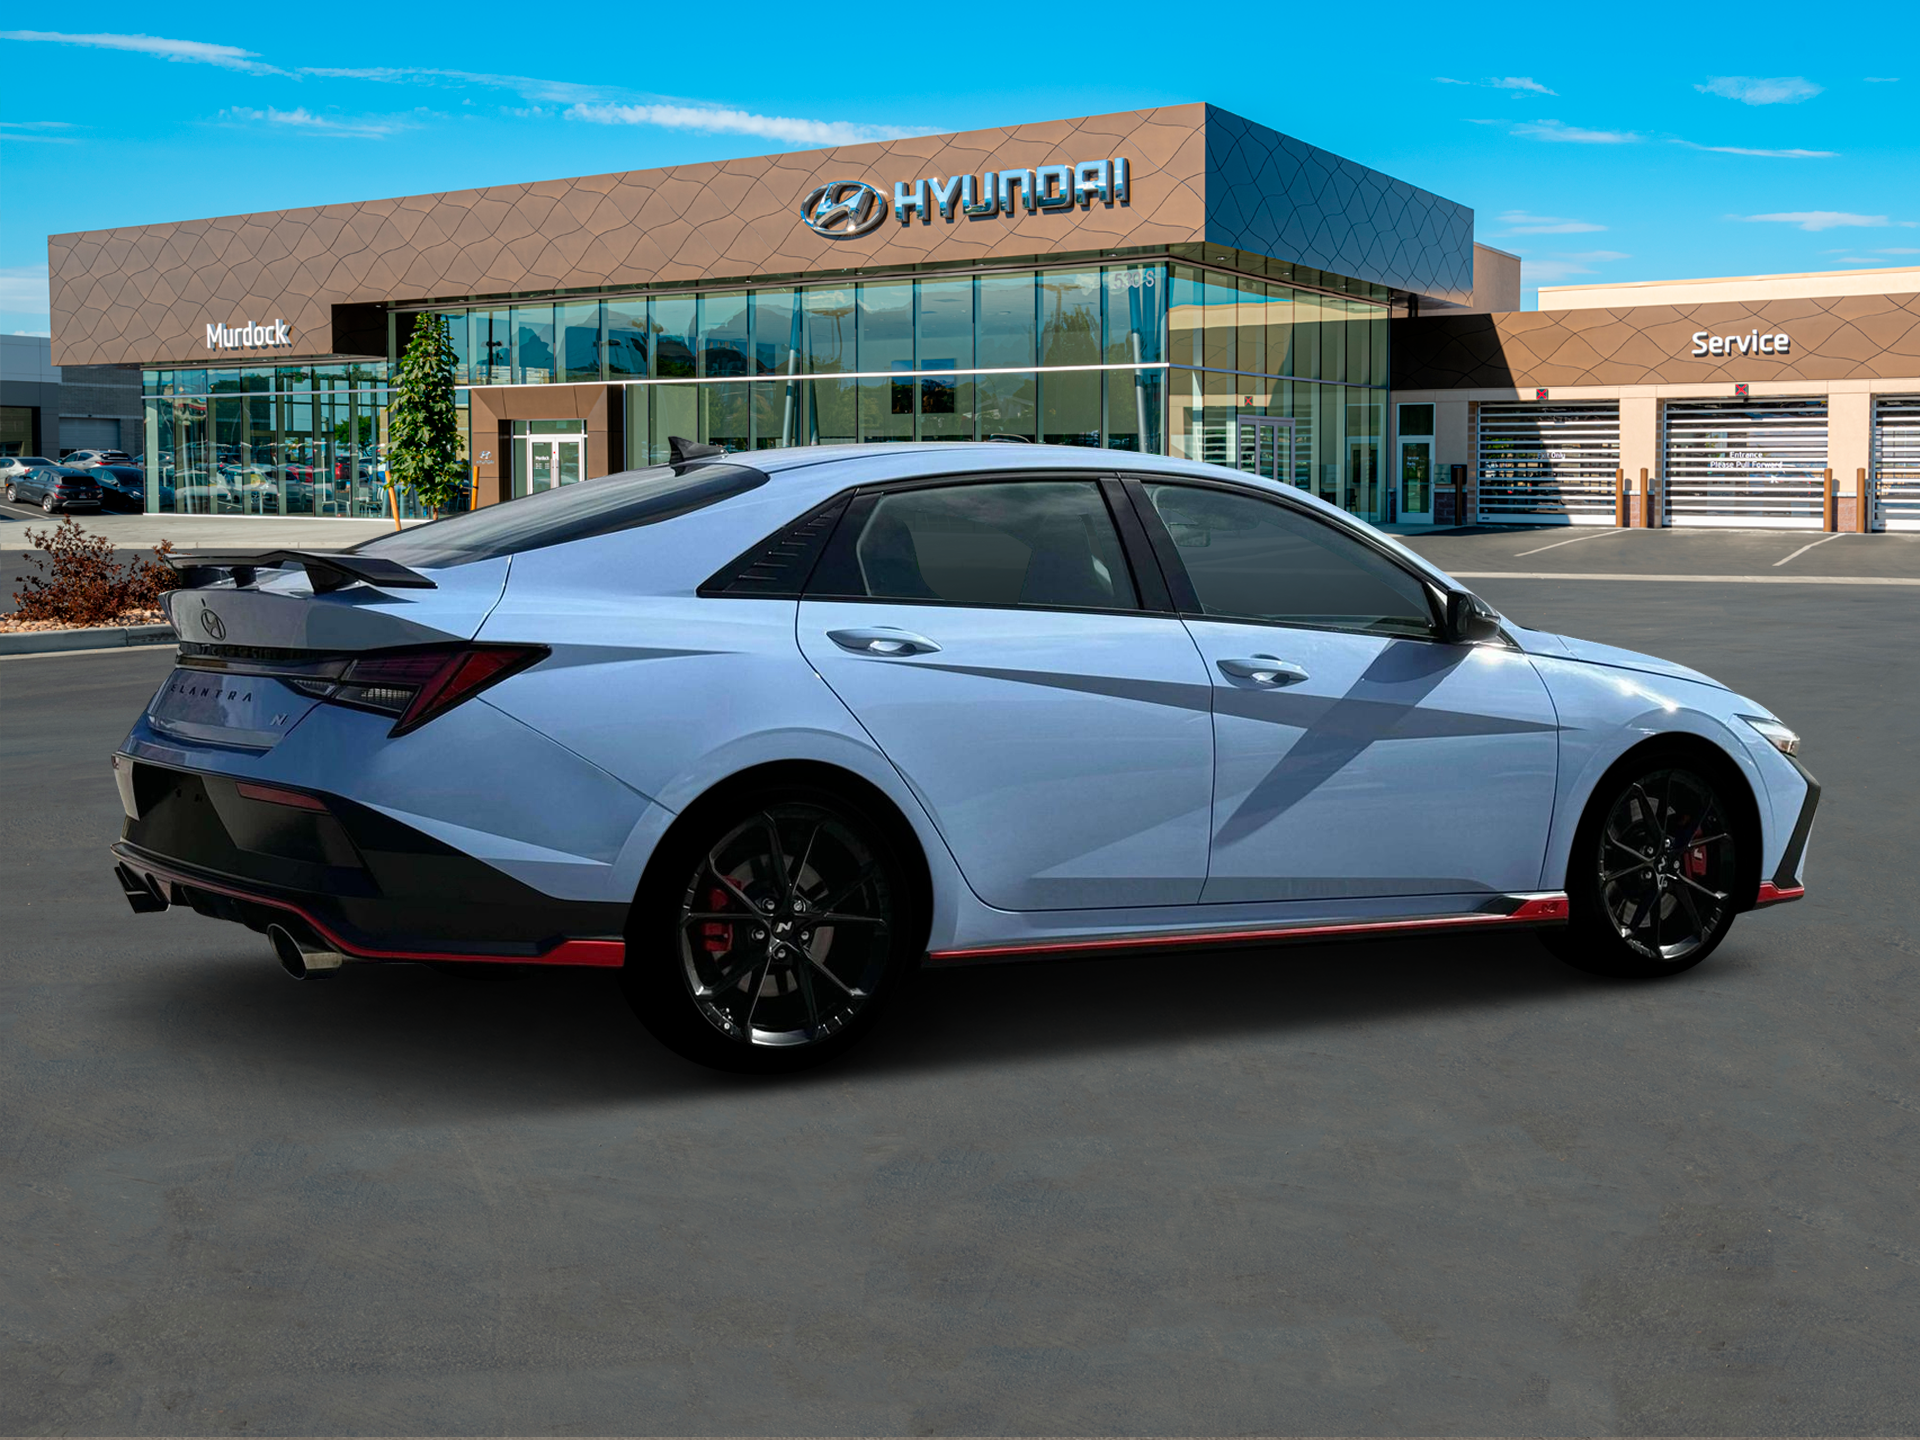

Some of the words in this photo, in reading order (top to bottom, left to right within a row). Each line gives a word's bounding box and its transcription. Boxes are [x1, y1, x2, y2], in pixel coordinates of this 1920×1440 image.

[894, 157, 1129, 224] HYUNDAI
[1113, 271, 1141, 289] 530
[1145, 270, 1155, 287] S
[206, 318, 291, 349] Murdock
[1691, 329, 1789, 355] Service
[1551, 451, 1566, 460] Only
[1729, 451, 1763, 459] Entrance
[1710, 461, 1734, 469] Please
[1736, 461, 1750, 469] Pull
[1752, 461, 1783, 469] Forward
[171, 683, 252, 702] ELANTRA
